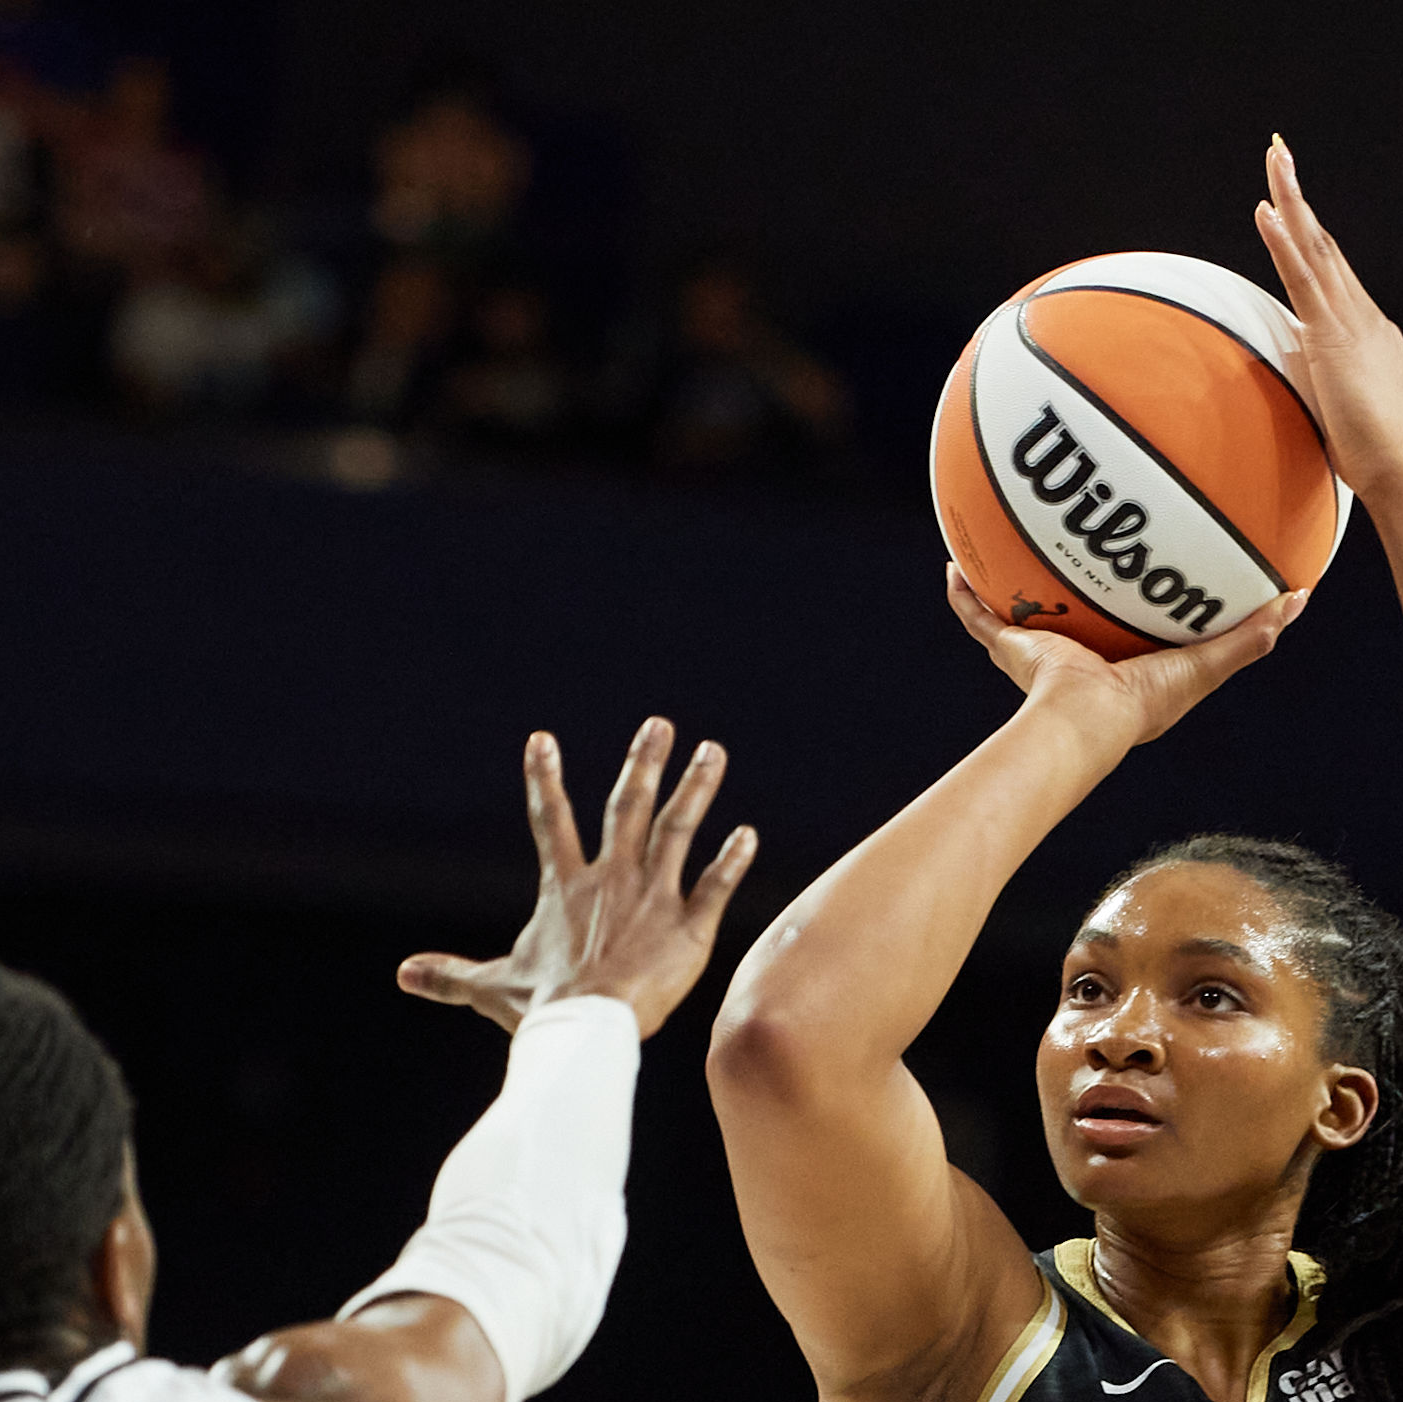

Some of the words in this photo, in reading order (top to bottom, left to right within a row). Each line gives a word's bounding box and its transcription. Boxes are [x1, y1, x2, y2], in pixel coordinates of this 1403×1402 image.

[1011, 401, 1225, 635] Wilson
[1055, 541, 1082, 568] EVO
[1084, 570, 1113, 593] NXT
